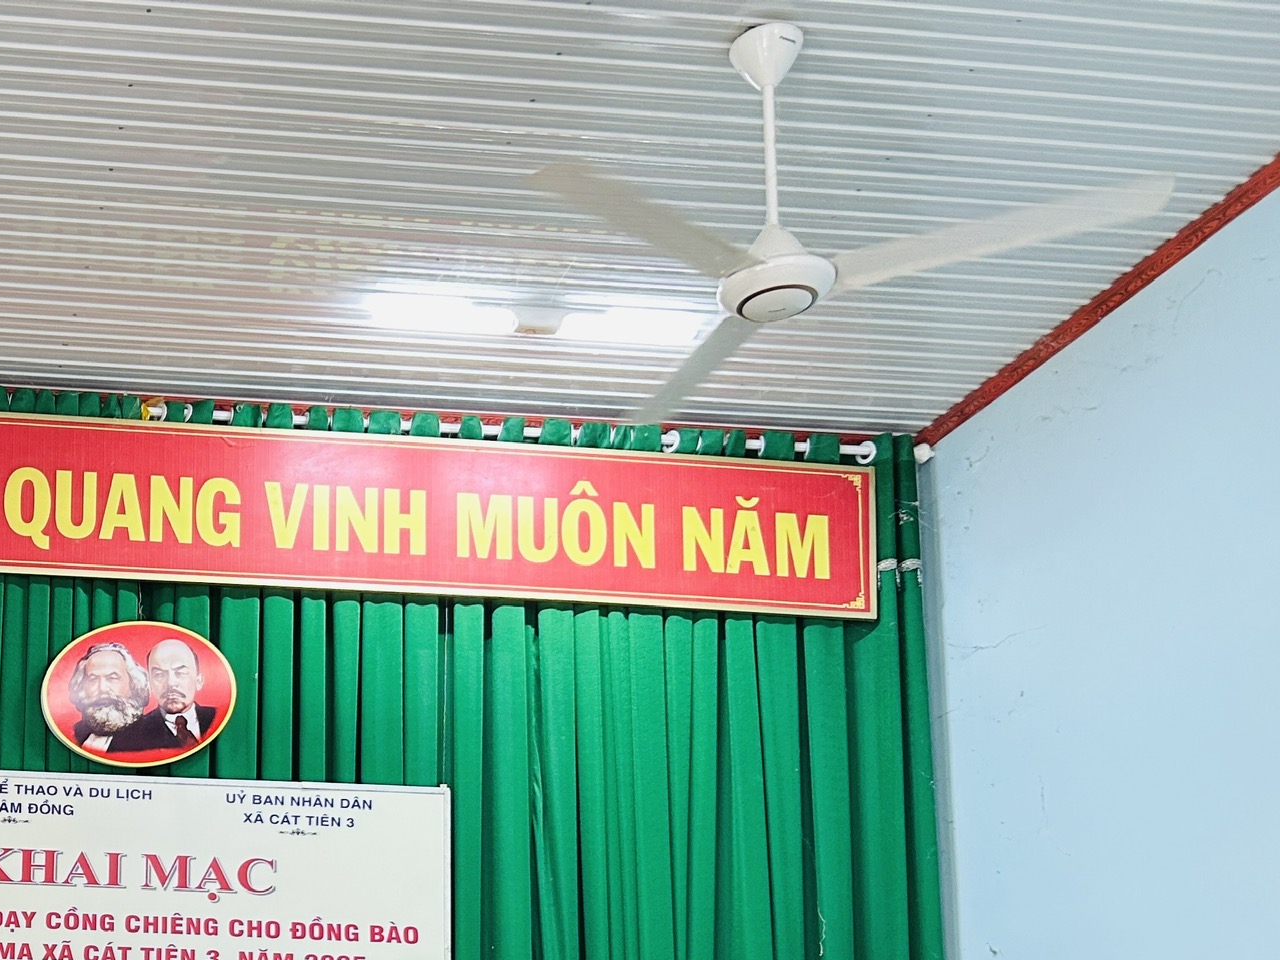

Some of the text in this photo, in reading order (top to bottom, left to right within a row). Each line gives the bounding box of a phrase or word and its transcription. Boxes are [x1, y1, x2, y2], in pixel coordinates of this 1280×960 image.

[5, 467, 240, 549] QUANG
[267, 483, 425, 554] VINH
[458, 481, 655, 568] MUÔN
[683, 497, 830, 579] NĂM
[14, 784, 58, 796] THAO
[62, 784, 84, 797] VÀ
[90, 788, 110, 798] DU
[117, 789, 151, 801] LỊCH
[227, 790, 373, 810] UỶ BAN NHÂN DÂN
[28, 800, 73, 815] ĐỒNG
[243, 810, 354, 827] XÃ CÁT TIÊN 3
[141, 853, 277, 902] MẠC
[45, 906, 115, 932] CỒNG
[124, 913, 219, 937] CHIÊNG
[229, 919, 280, 939] CHO
[289, 916, 360, 943] ĐỒNG
[369, 921, 420, 945] BÀO
